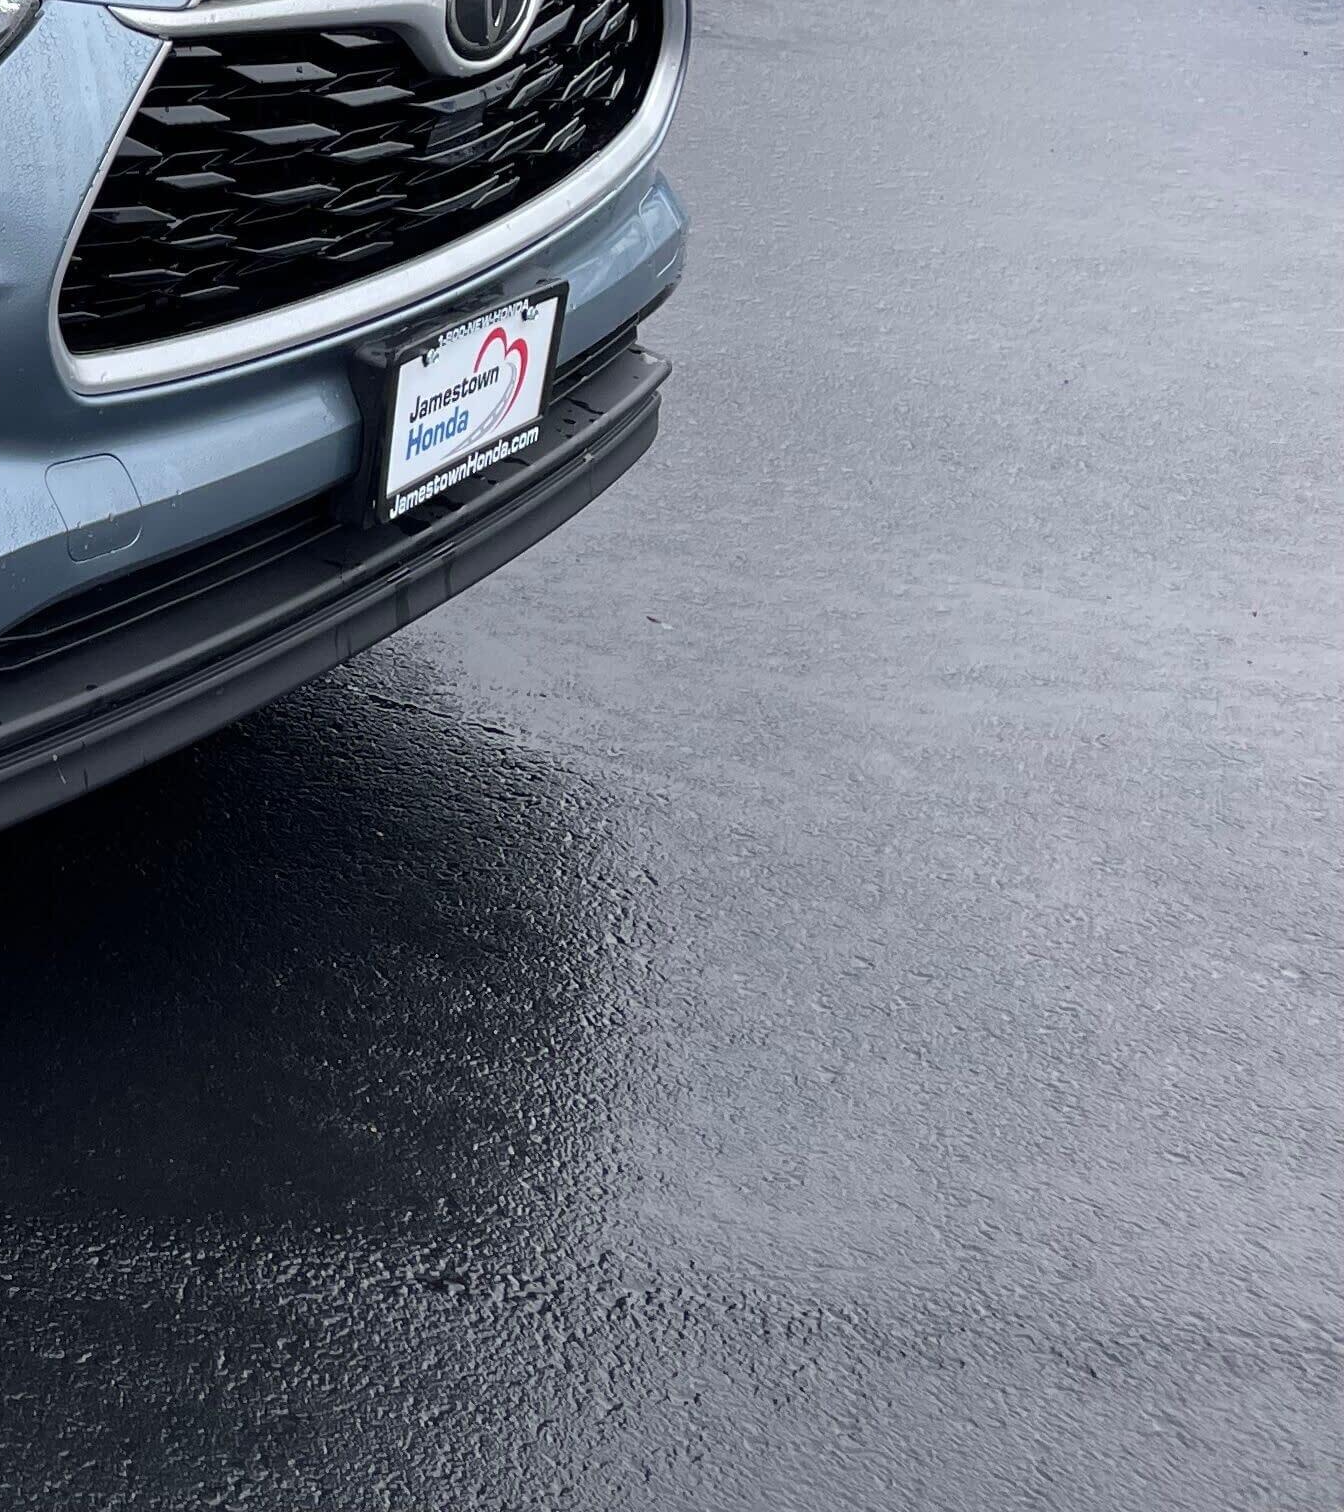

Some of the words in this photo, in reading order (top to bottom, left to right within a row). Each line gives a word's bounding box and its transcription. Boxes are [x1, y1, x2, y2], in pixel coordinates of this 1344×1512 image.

[409, 365, 500, 424] Jamestown
[405, 405, 470, 461] Honda
[389, 425, 540, 520] JamestownHonda.com
